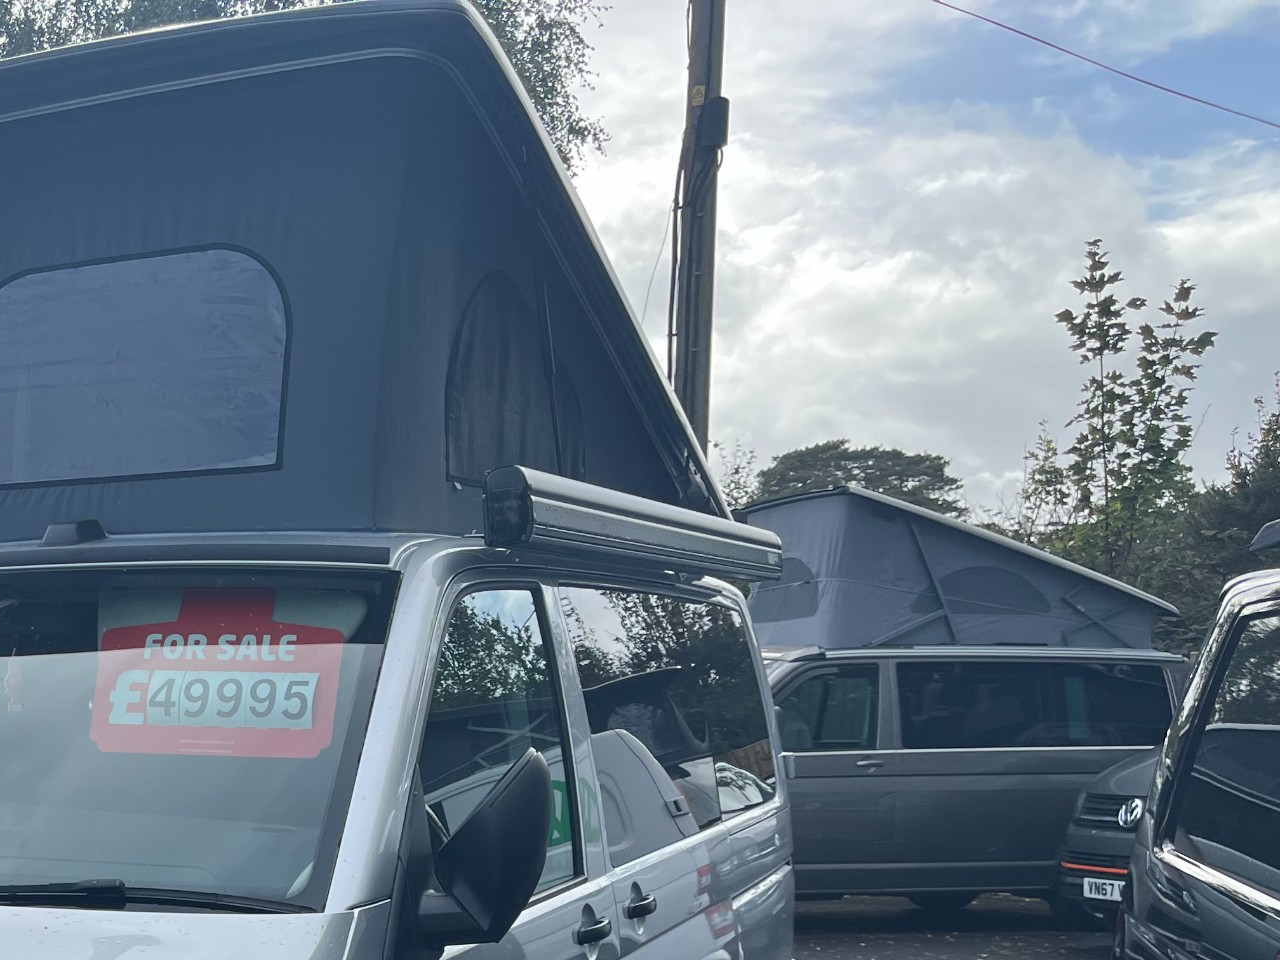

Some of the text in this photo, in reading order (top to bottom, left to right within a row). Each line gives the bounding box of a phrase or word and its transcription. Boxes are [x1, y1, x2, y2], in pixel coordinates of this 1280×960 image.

[143, 633, 298, 662] FOR SALE
[108, 669, 312, 725] £49995
